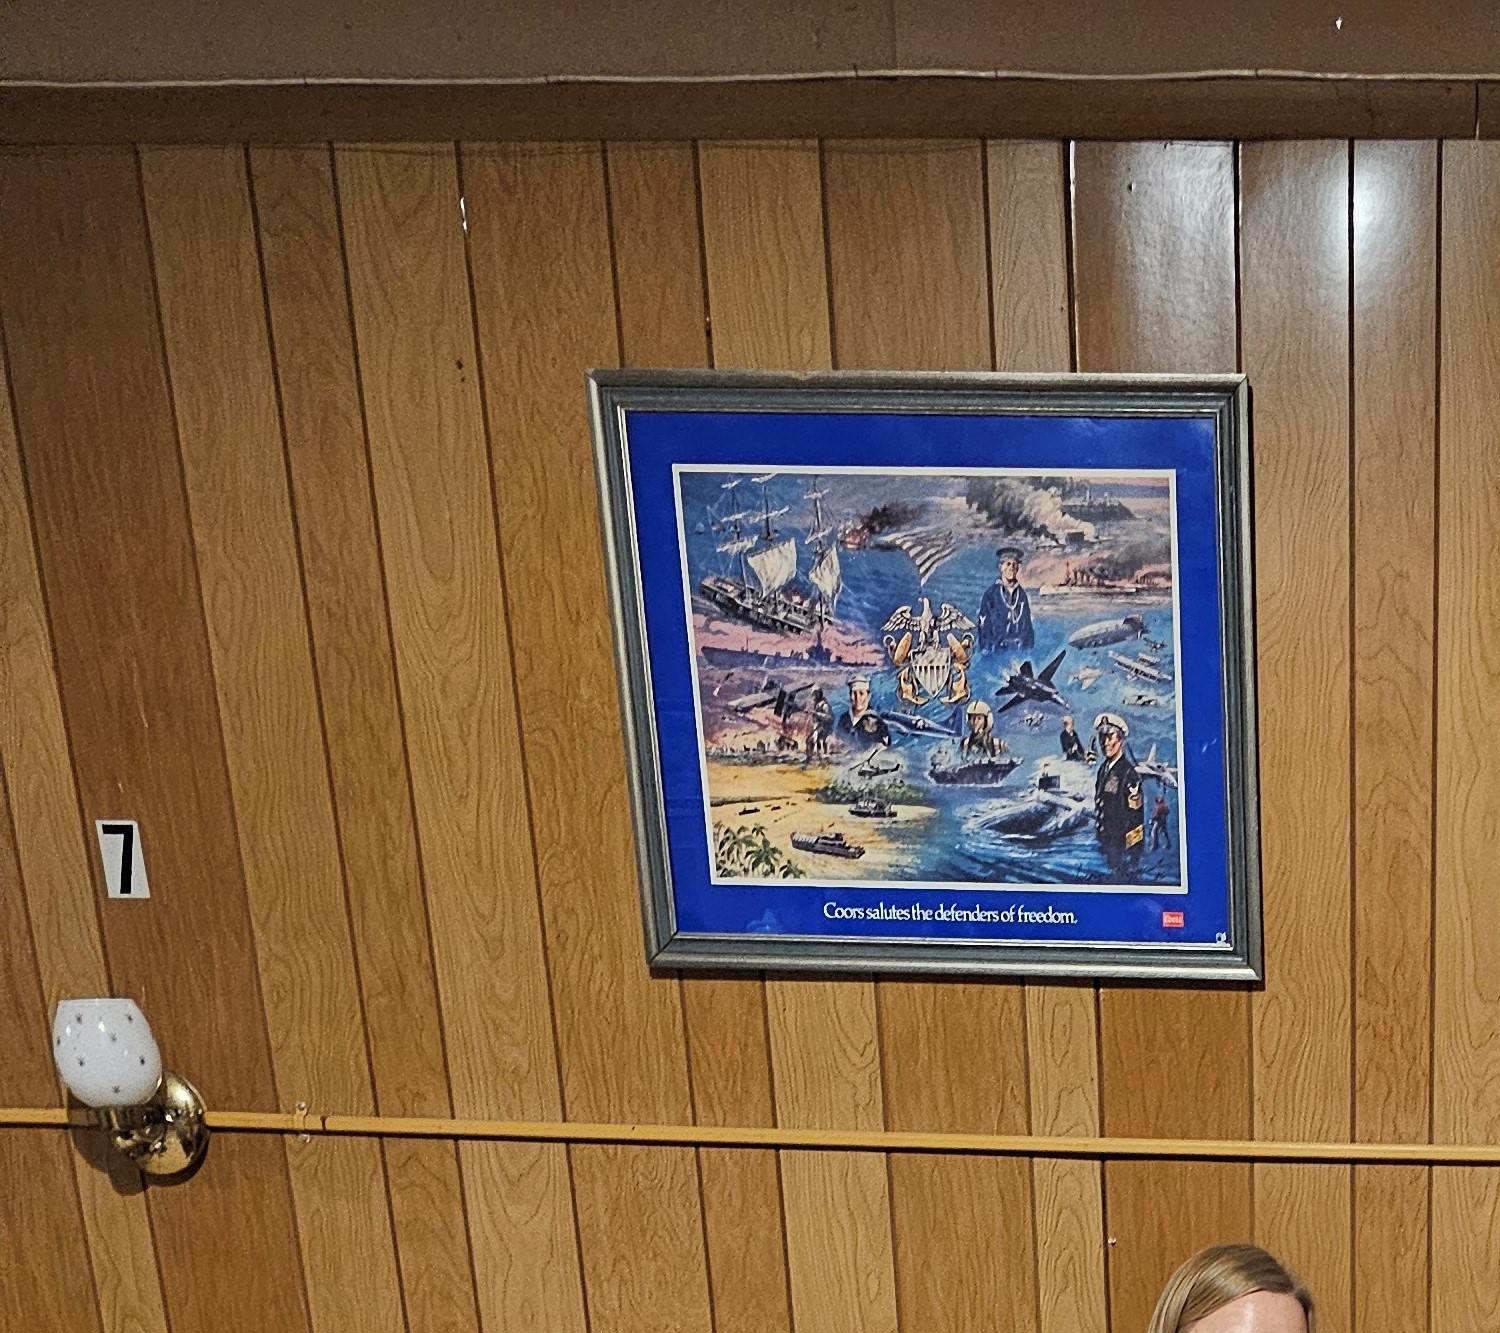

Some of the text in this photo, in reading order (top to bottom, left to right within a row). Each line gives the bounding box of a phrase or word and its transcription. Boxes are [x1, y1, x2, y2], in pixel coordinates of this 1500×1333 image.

[102, 824, 133, 894] 7
[823, 901, 1078, 925] Coors salutes the defenders of freedom.
